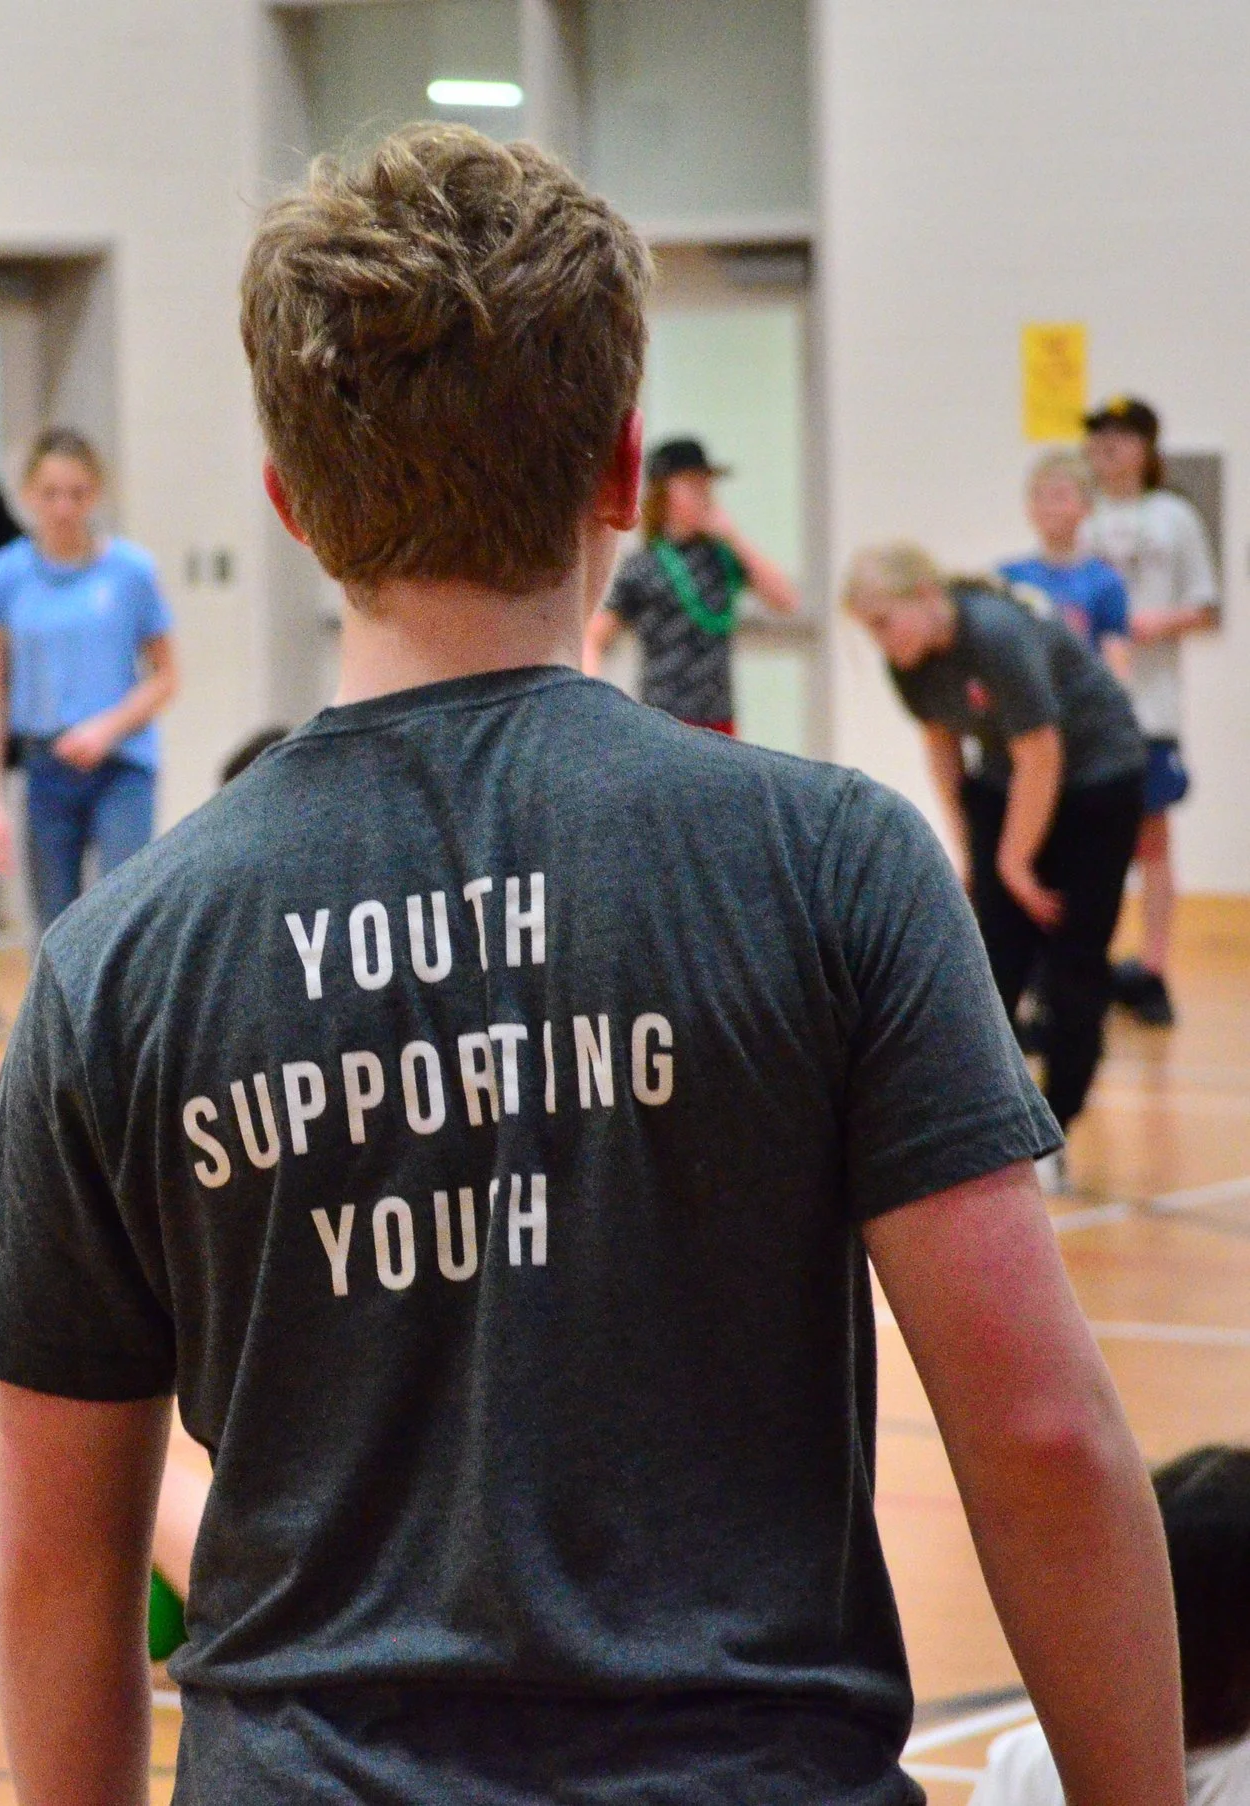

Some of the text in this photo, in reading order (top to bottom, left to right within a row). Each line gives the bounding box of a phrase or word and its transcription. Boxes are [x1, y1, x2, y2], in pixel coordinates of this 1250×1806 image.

[285, 872, 546, 999] YOUTH
[183, 1012, 674, 1189] SUPPORTING
[312, 1174, 547, 1297] YOUH
